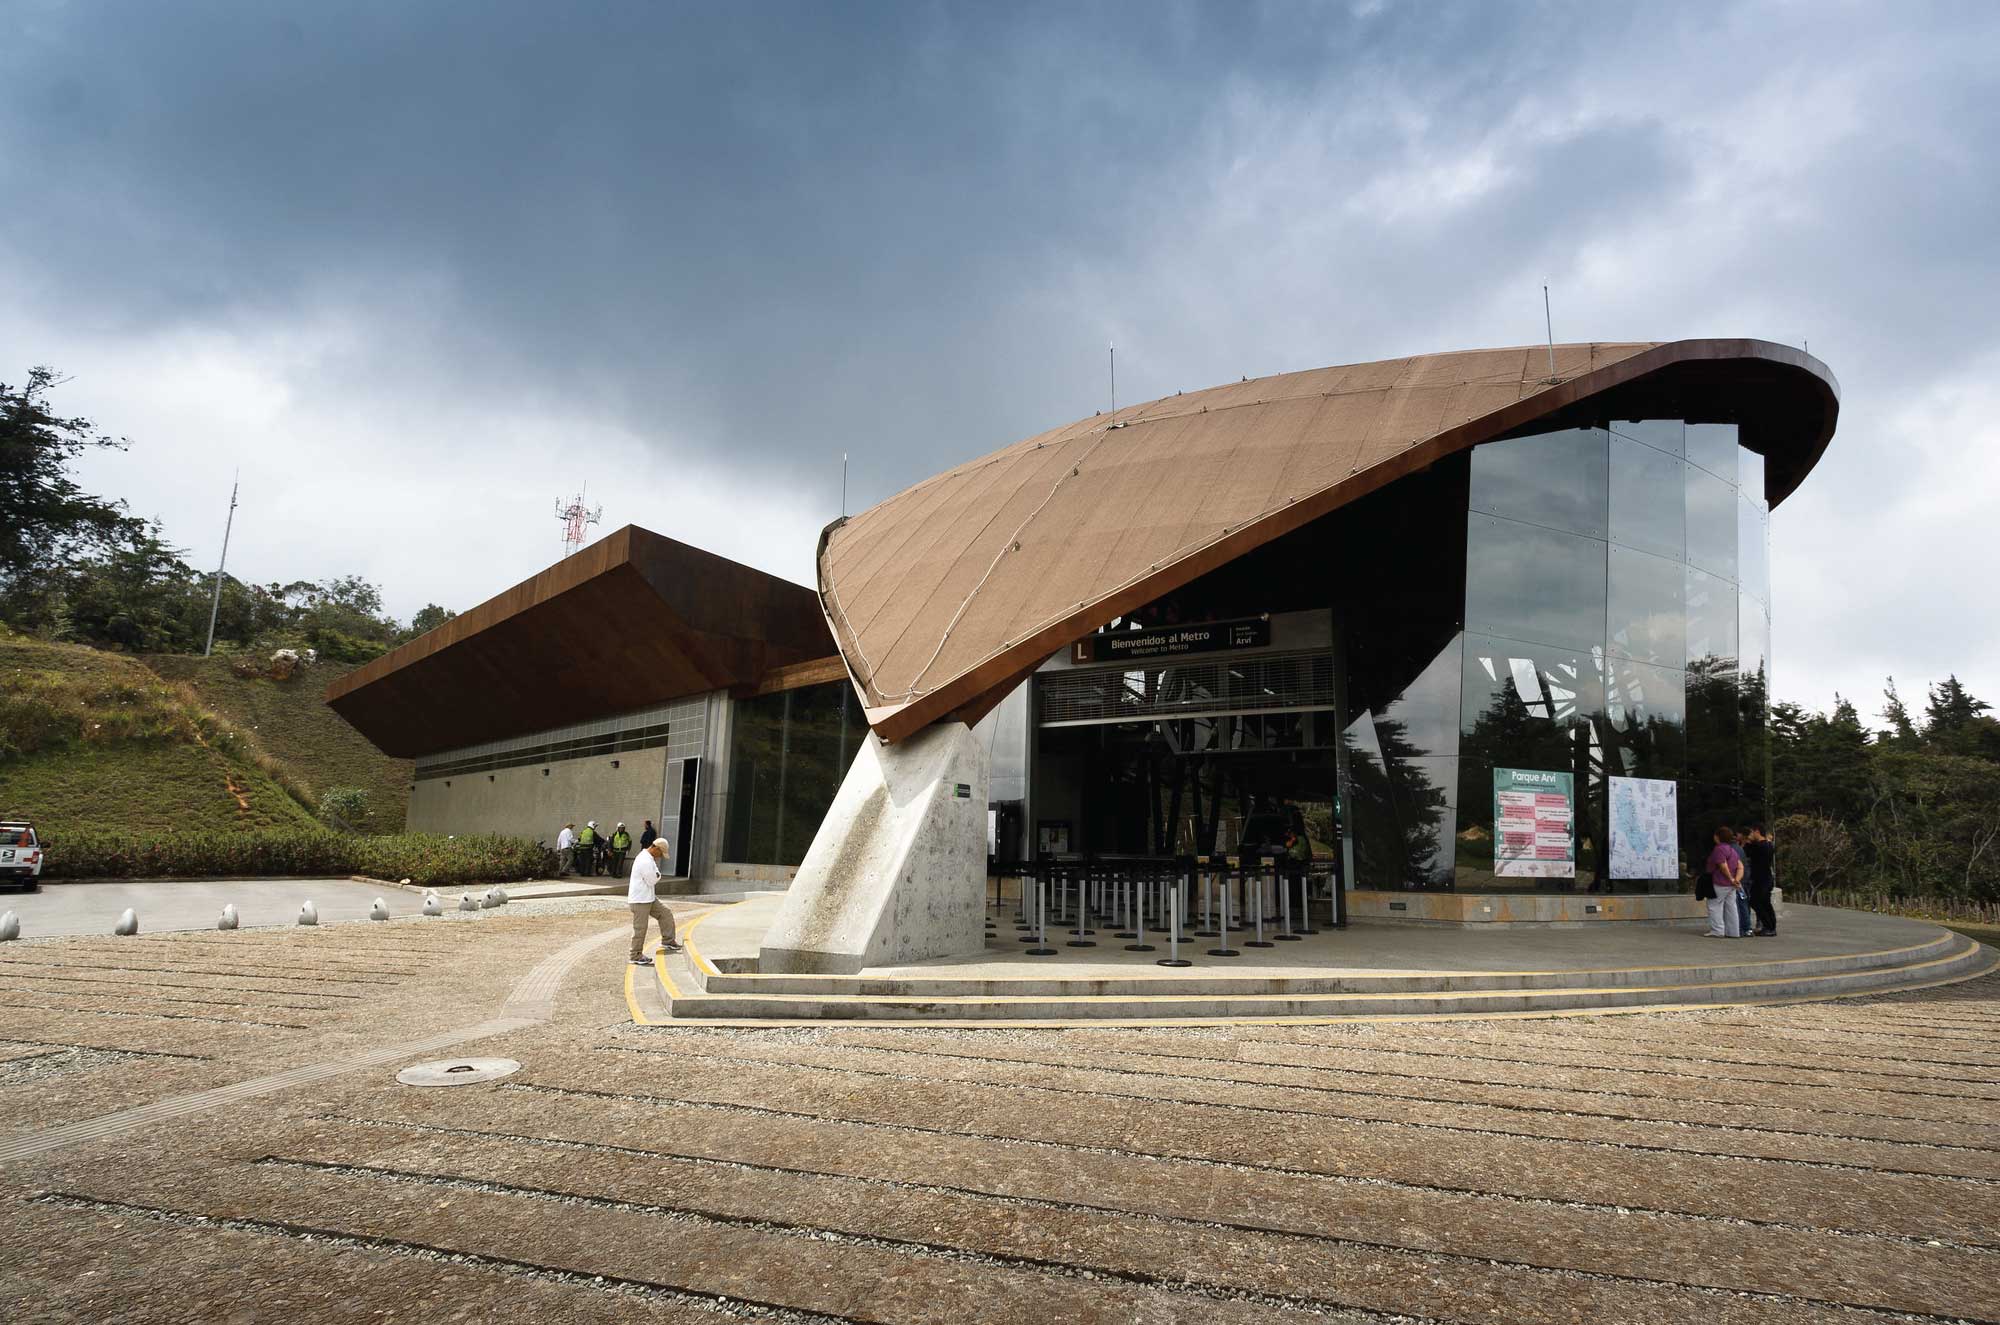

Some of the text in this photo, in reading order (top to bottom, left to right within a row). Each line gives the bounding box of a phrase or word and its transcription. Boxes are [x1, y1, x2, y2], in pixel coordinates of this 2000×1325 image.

[1111, 631, 1210, 650] Bienvenidos al Metro
[1077, 643, 1087, 660] L
[1131, 648, 1159, 656] Welcome
[1169, 643, 1189, 651] Metro
[1511, 770, 1540, 784] Parque
